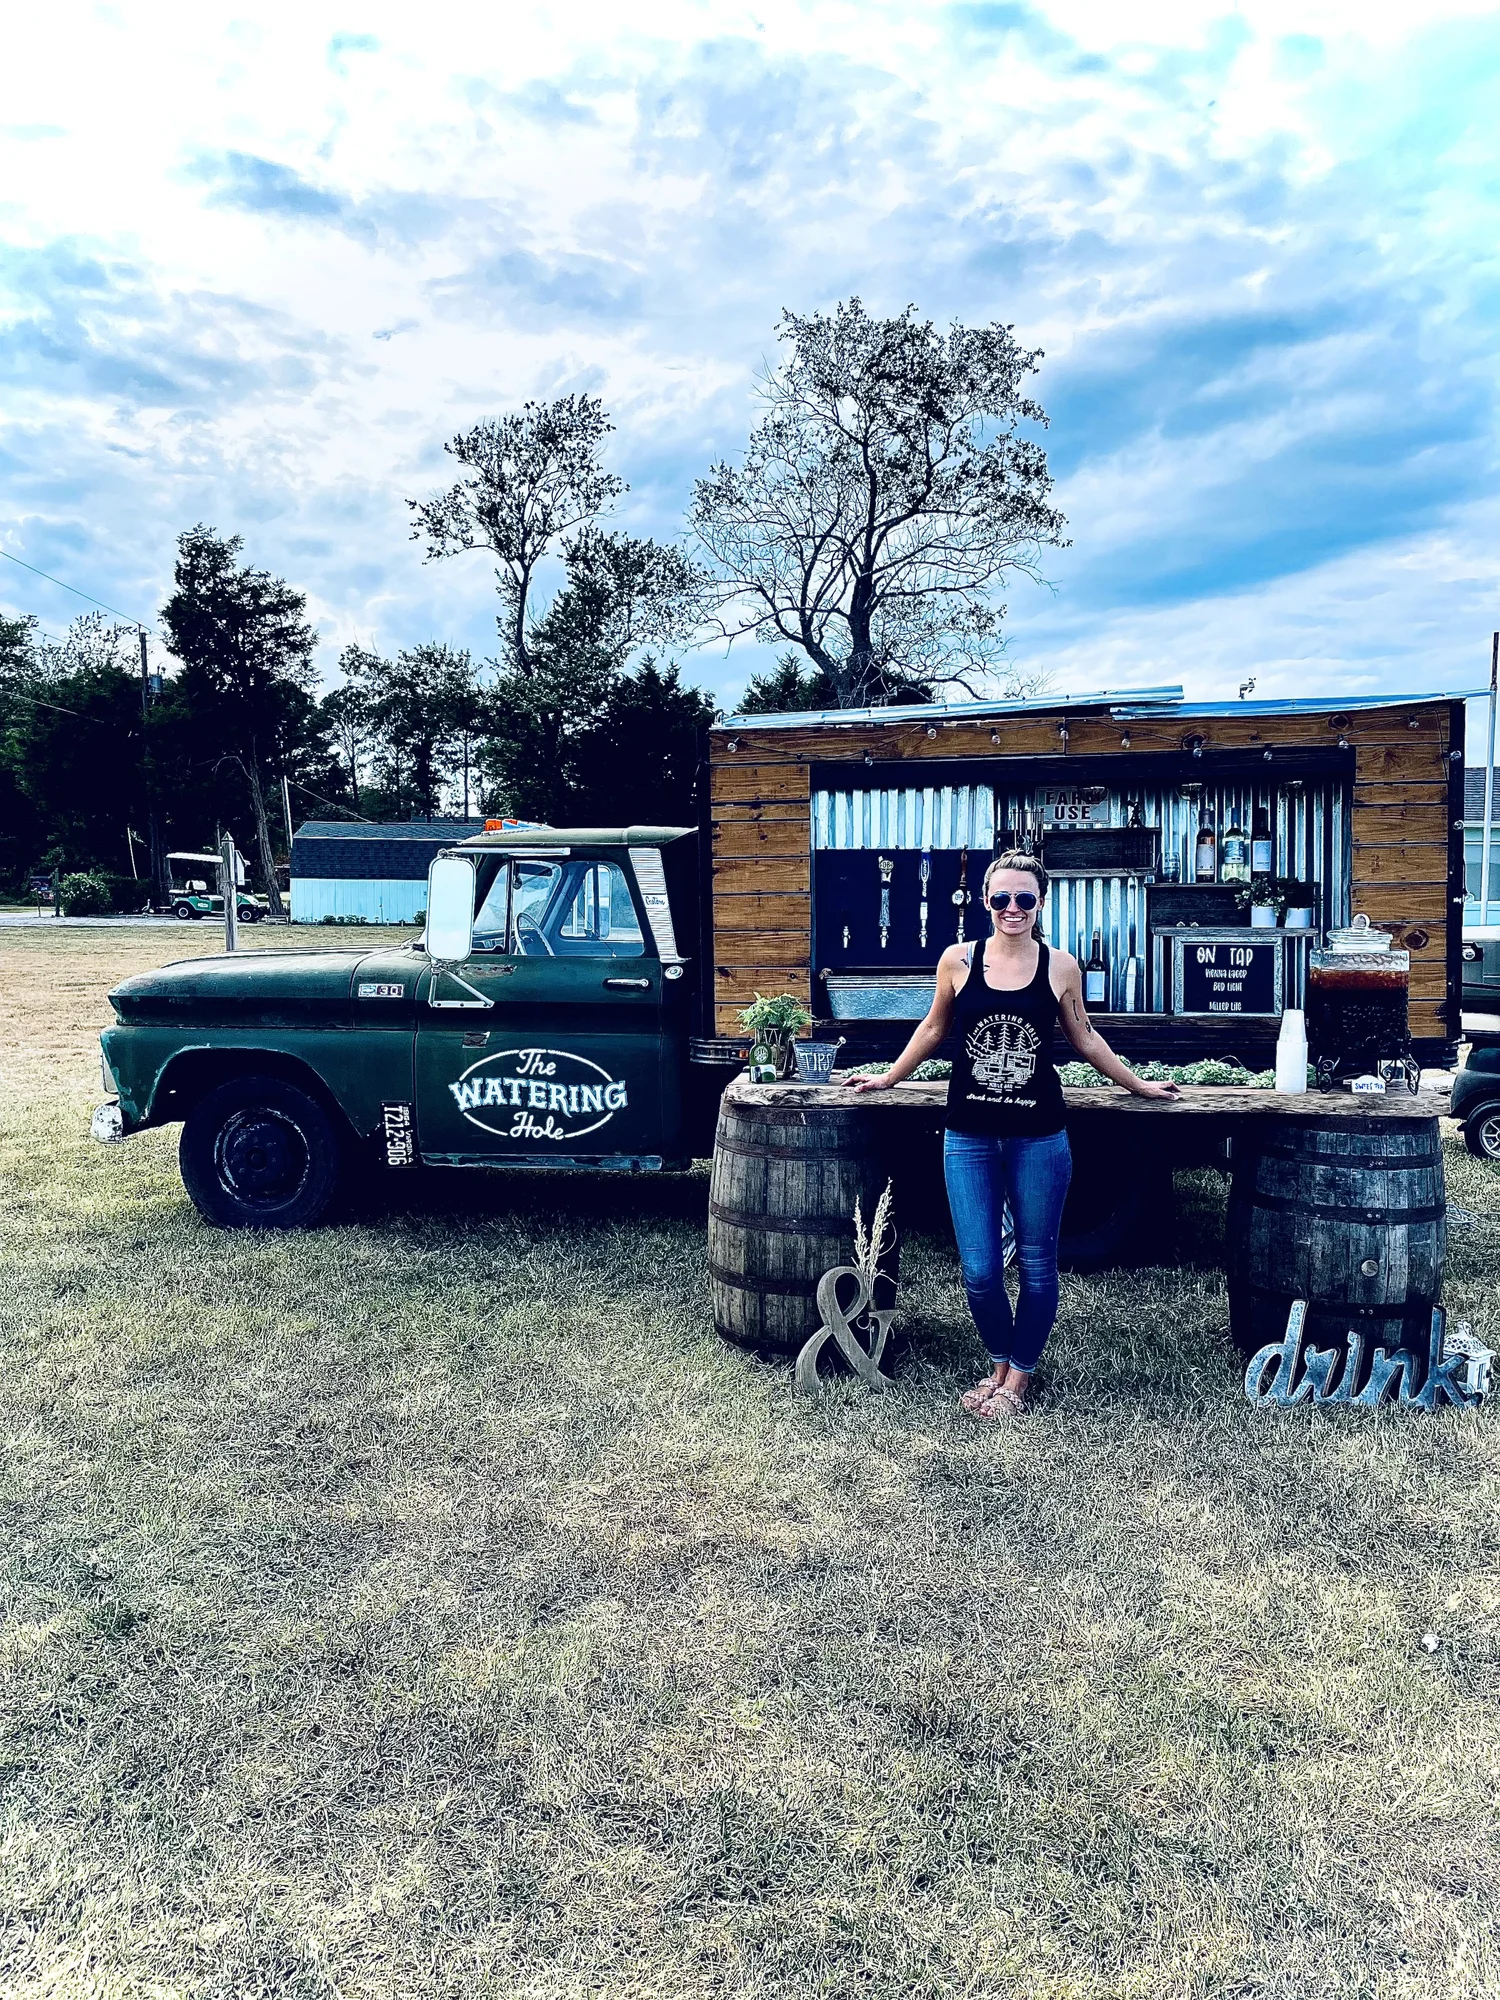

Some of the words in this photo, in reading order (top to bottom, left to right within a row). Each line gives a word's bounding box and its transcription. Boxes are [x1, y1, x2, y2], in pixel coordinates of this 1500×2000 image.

[1045, 791, 1101, 805] FAR
[1054, 806, 1091, 820] USE
[1196, 946, 1216, 963] ON
[1230, 947, 1253, 966] TAP
[380, 986, 399, 995] 30
[976, 1013, 1024, 1028] WATERING
[1024, 1022, 1040, 1043] HOLE
[516, 1049, 557, 1076] The
[800, 1053, 832, 1072] TIPS
[448, 1077, 629, 1118] WATERING
[510, 1111, 564, 1140] Hole
[1245, 1299, 1484, 1411] drink
